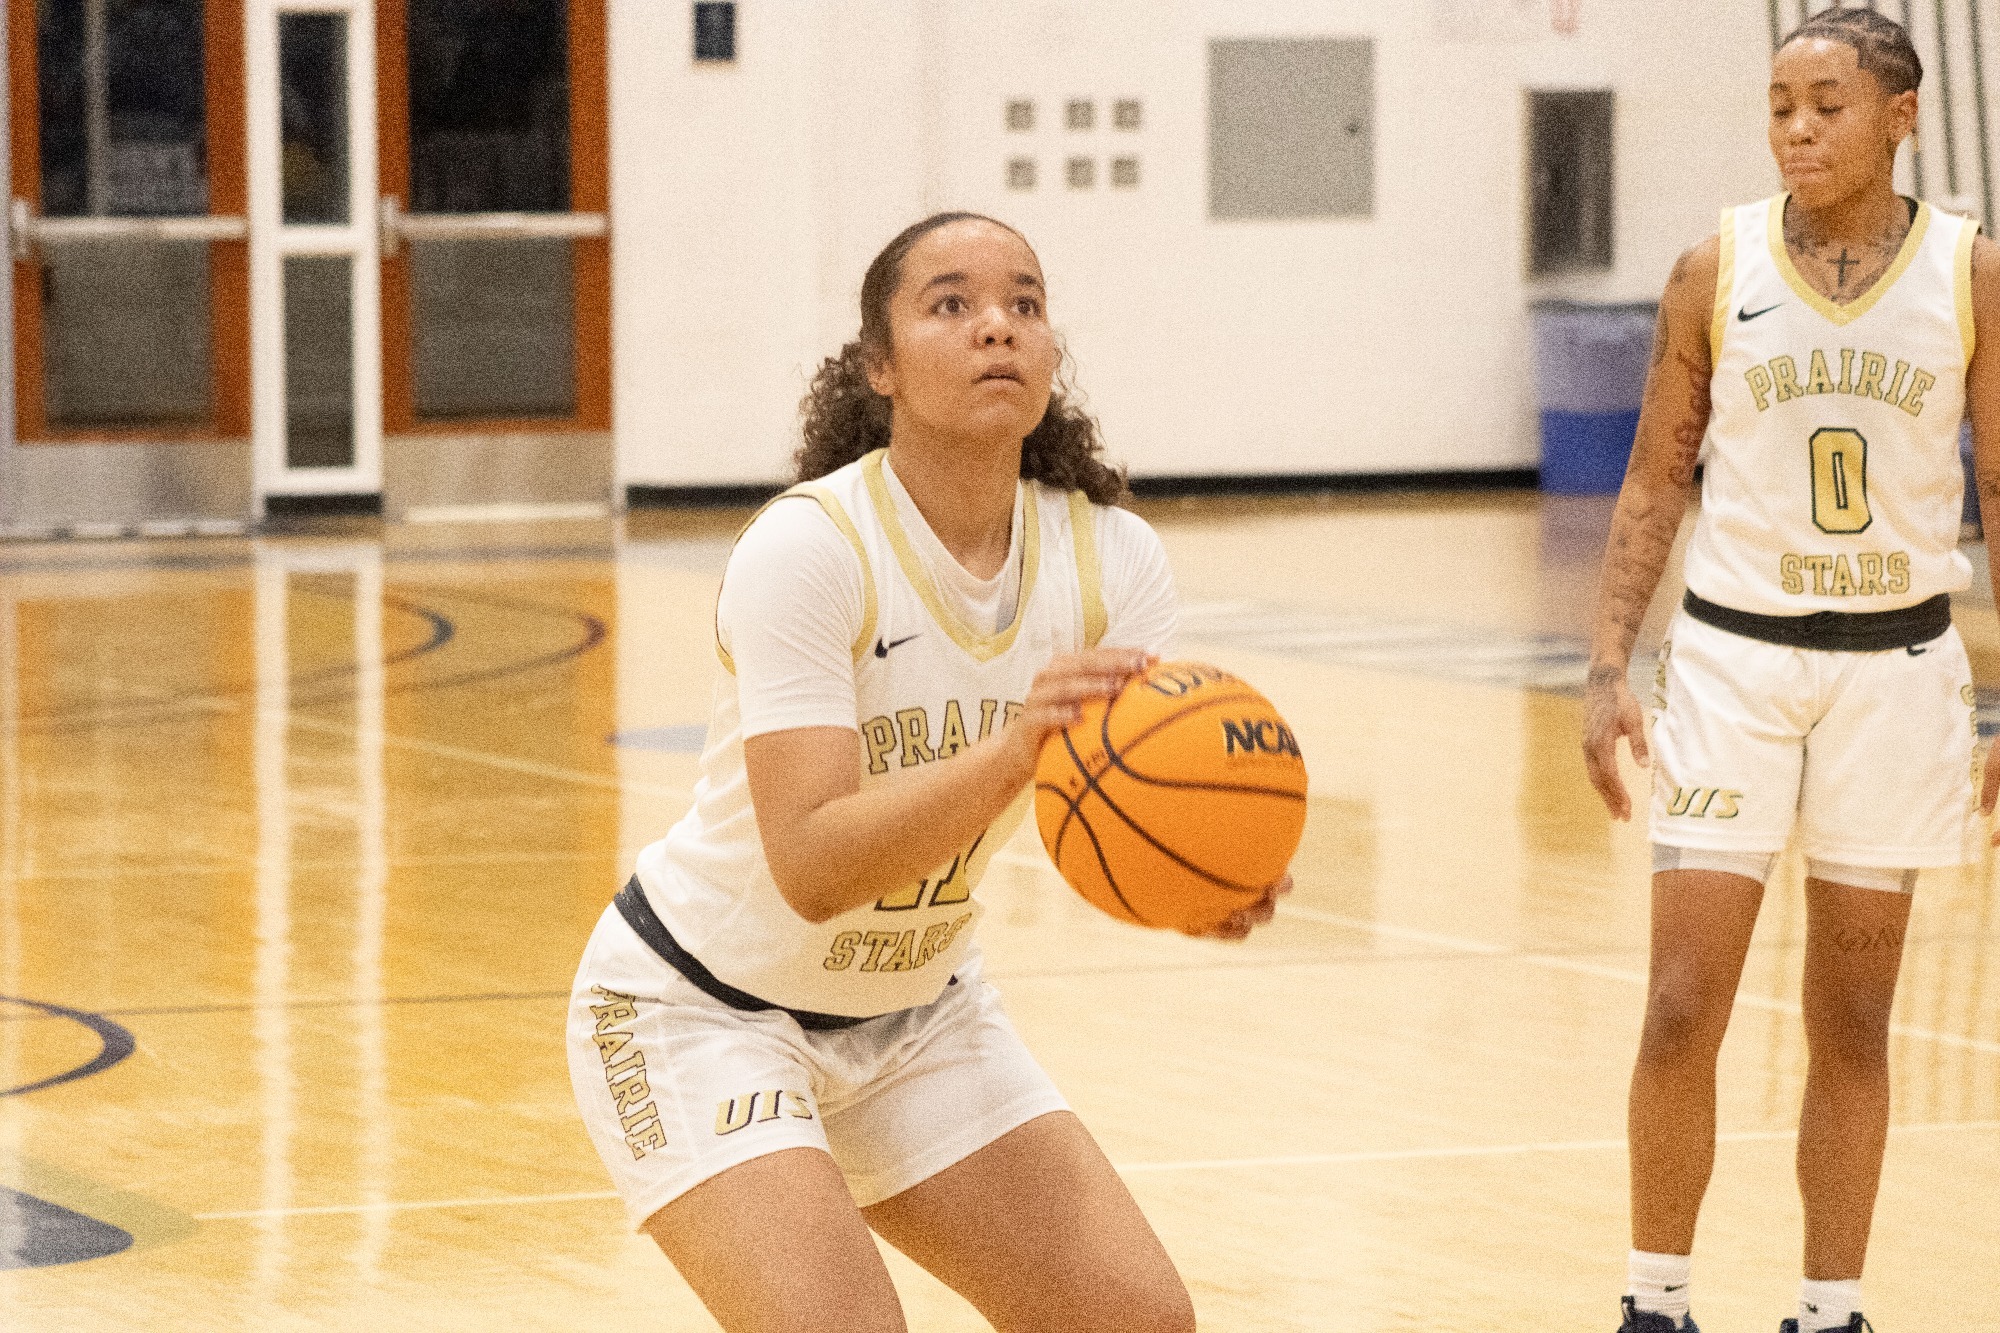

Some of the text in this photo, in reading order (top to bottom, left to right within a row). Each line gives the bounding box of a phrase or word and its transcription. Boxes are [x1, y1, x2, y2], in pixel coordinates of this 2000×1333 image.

[1744, 348, 1936, 418] PRAIRIE
[1809, 427, 1873, 535] 0
[1780, 552, 1911, 596] STARS
[1666, 787, 1743, 818] UIS
[822, 912, 972, 973] STARS
[714, 1088, 813, 1135] UIS
